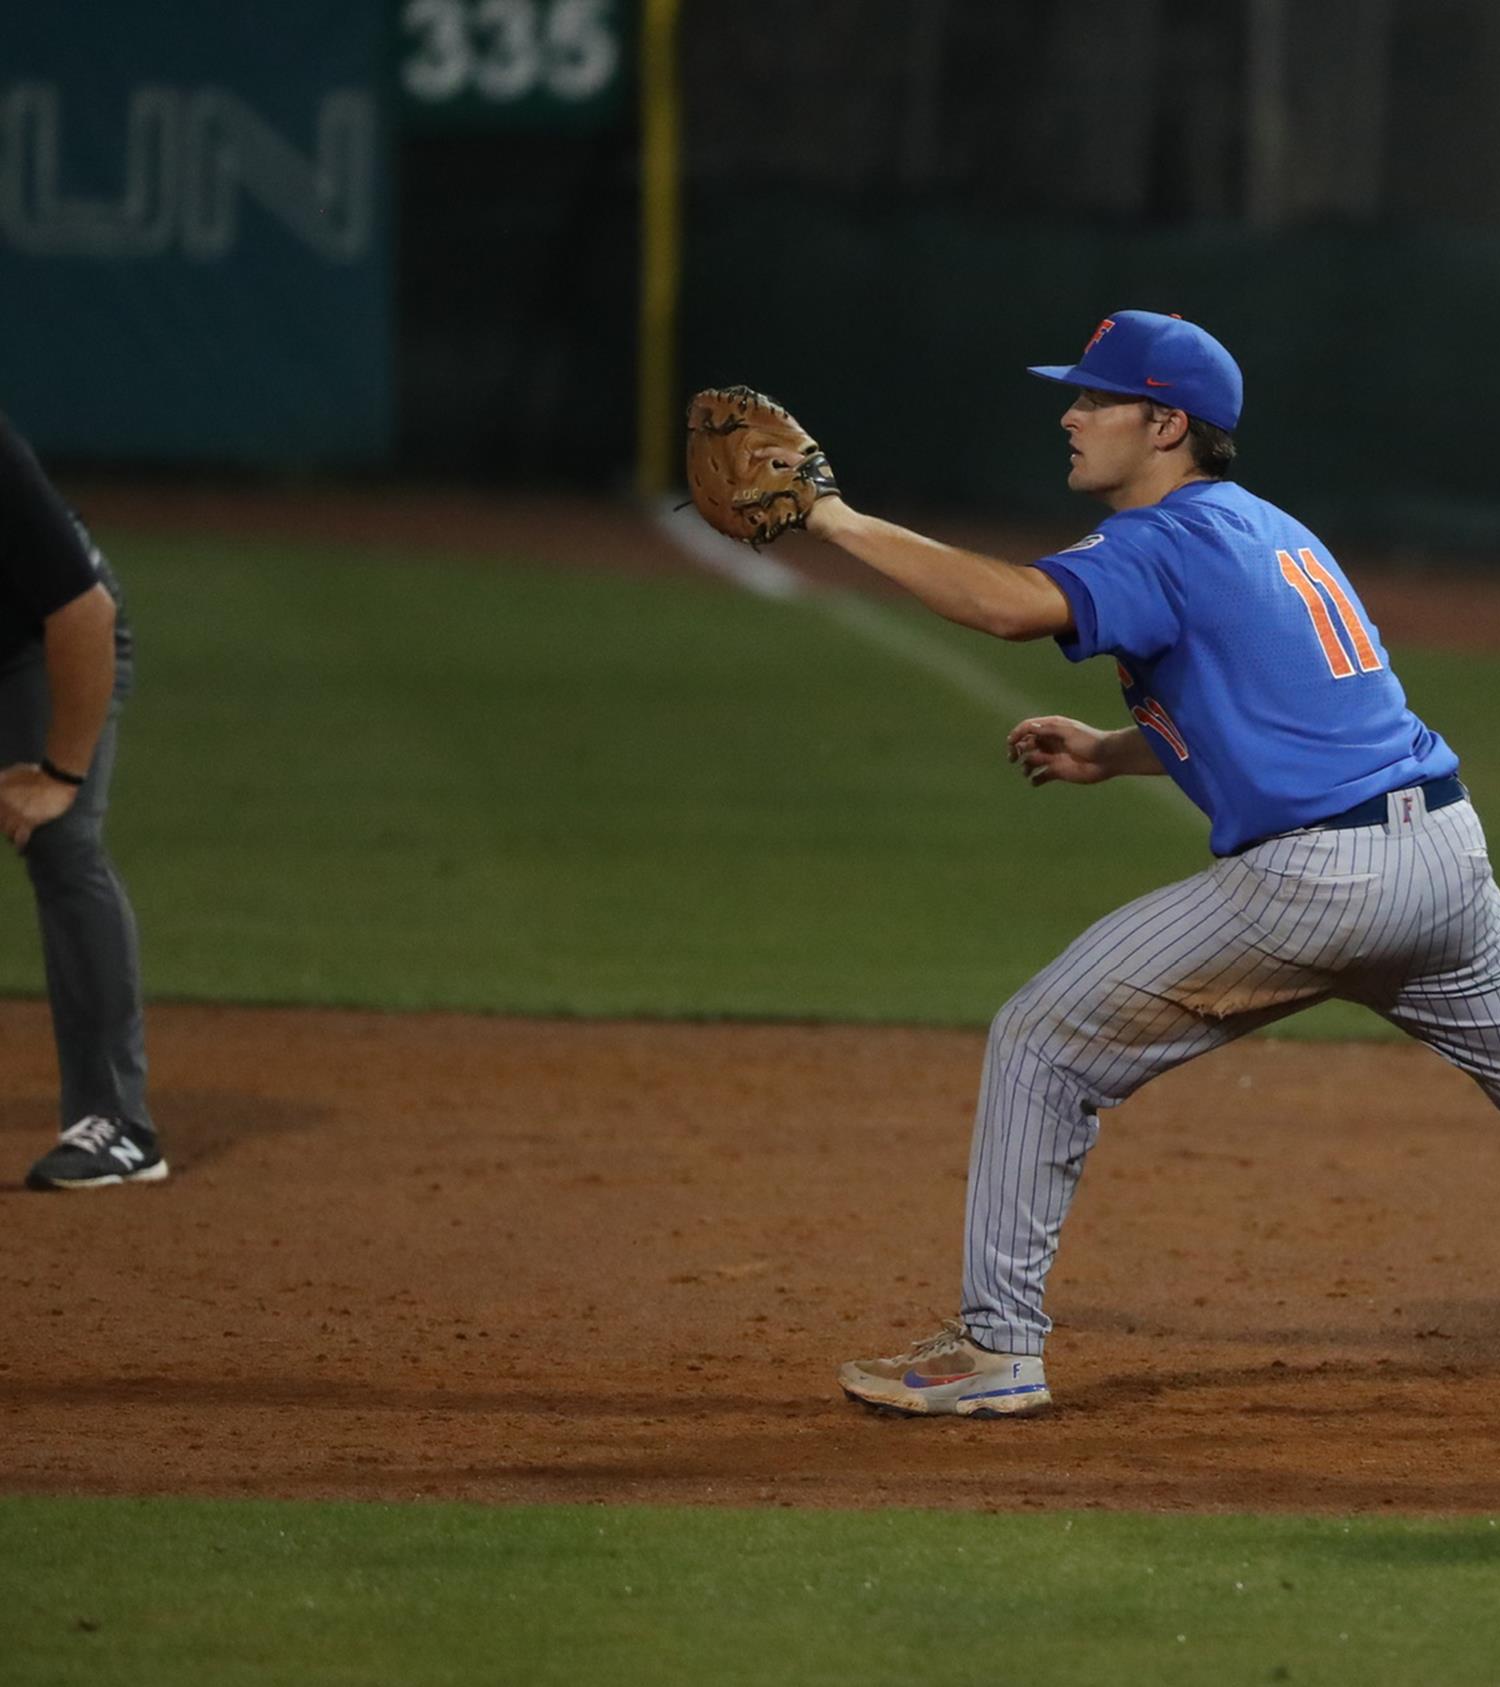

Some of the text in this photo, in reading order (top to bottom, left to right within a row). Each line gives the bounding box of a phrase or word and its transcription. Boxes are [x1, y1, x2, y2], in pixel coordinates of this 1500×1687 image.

[402, 0, 614, 98] 335
[1275, 547, 1383, 679] 11
[1012, 1362, 1021, 1379] F
